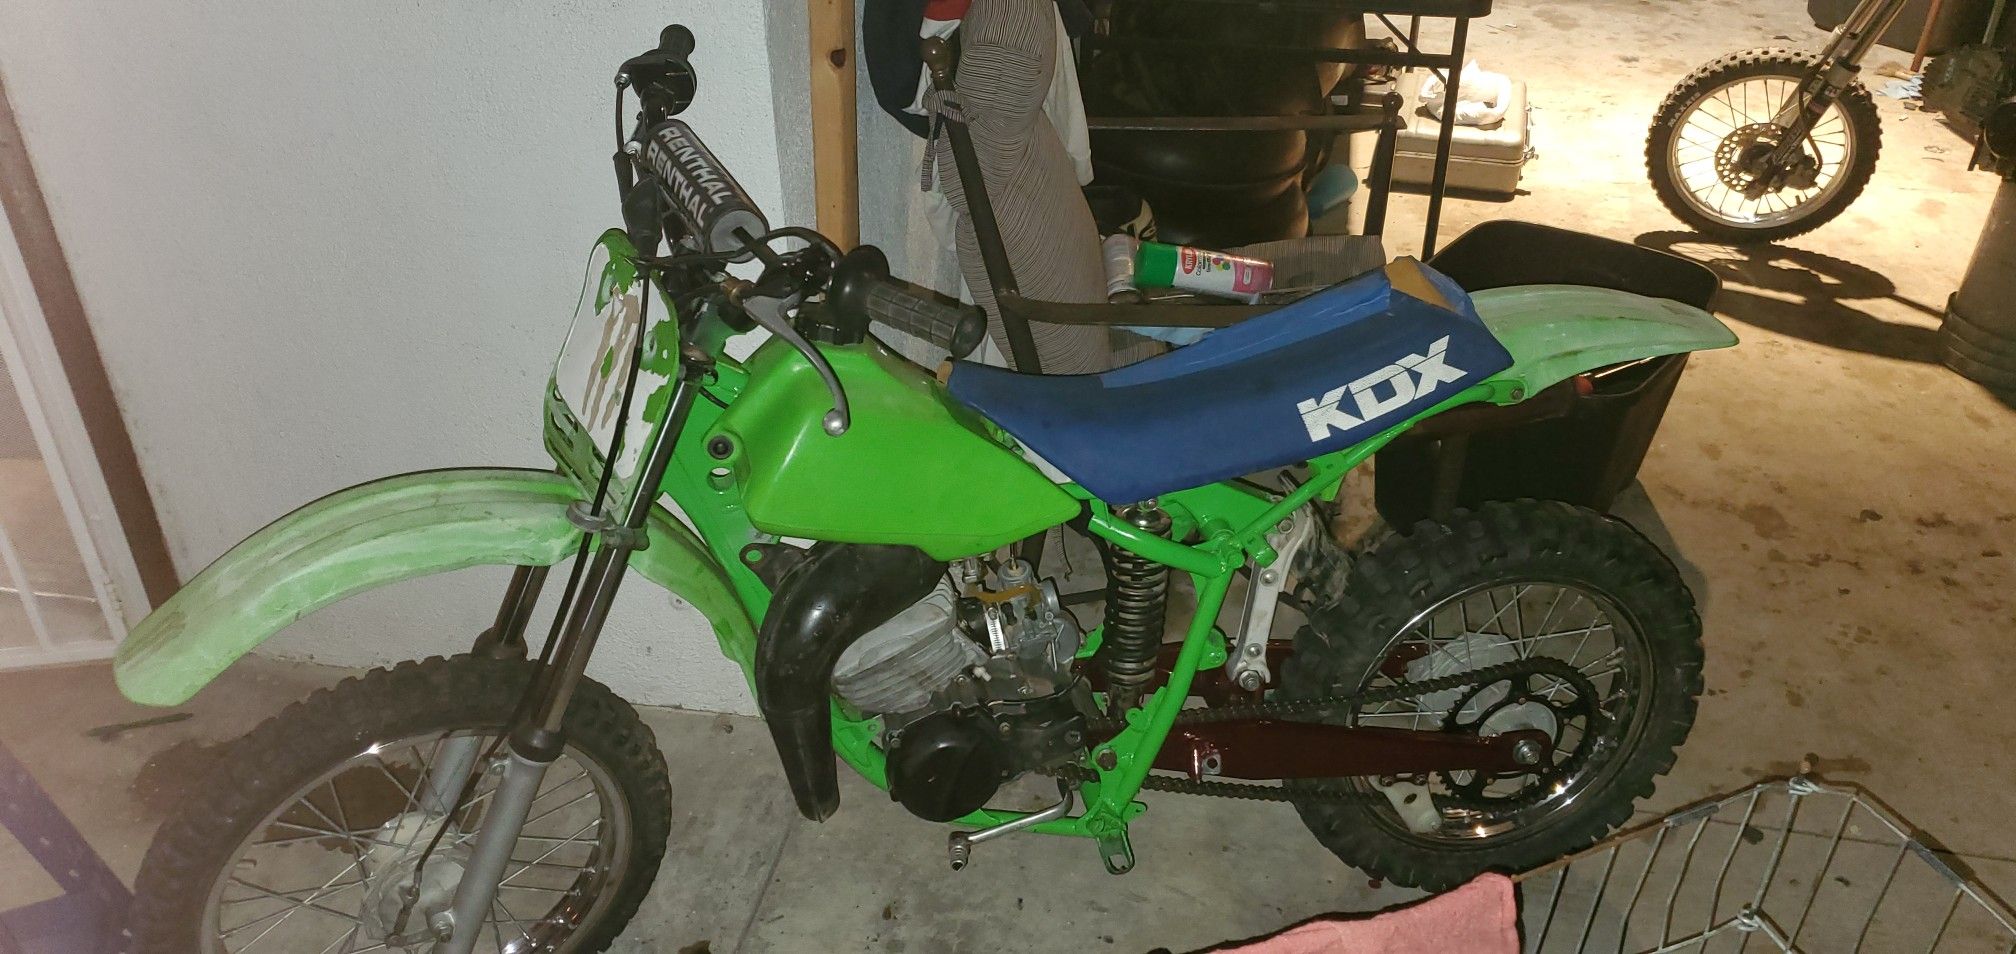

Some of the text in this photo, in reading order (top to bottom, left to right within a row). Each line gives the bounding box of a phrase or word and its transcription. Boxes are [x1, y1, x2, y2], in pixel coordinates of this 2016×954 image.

[647, 140, 708, 228] RENTHAL
[659, 127, 732, 205] RENTHAL
[1297, 335, 1468, 442] KDX
